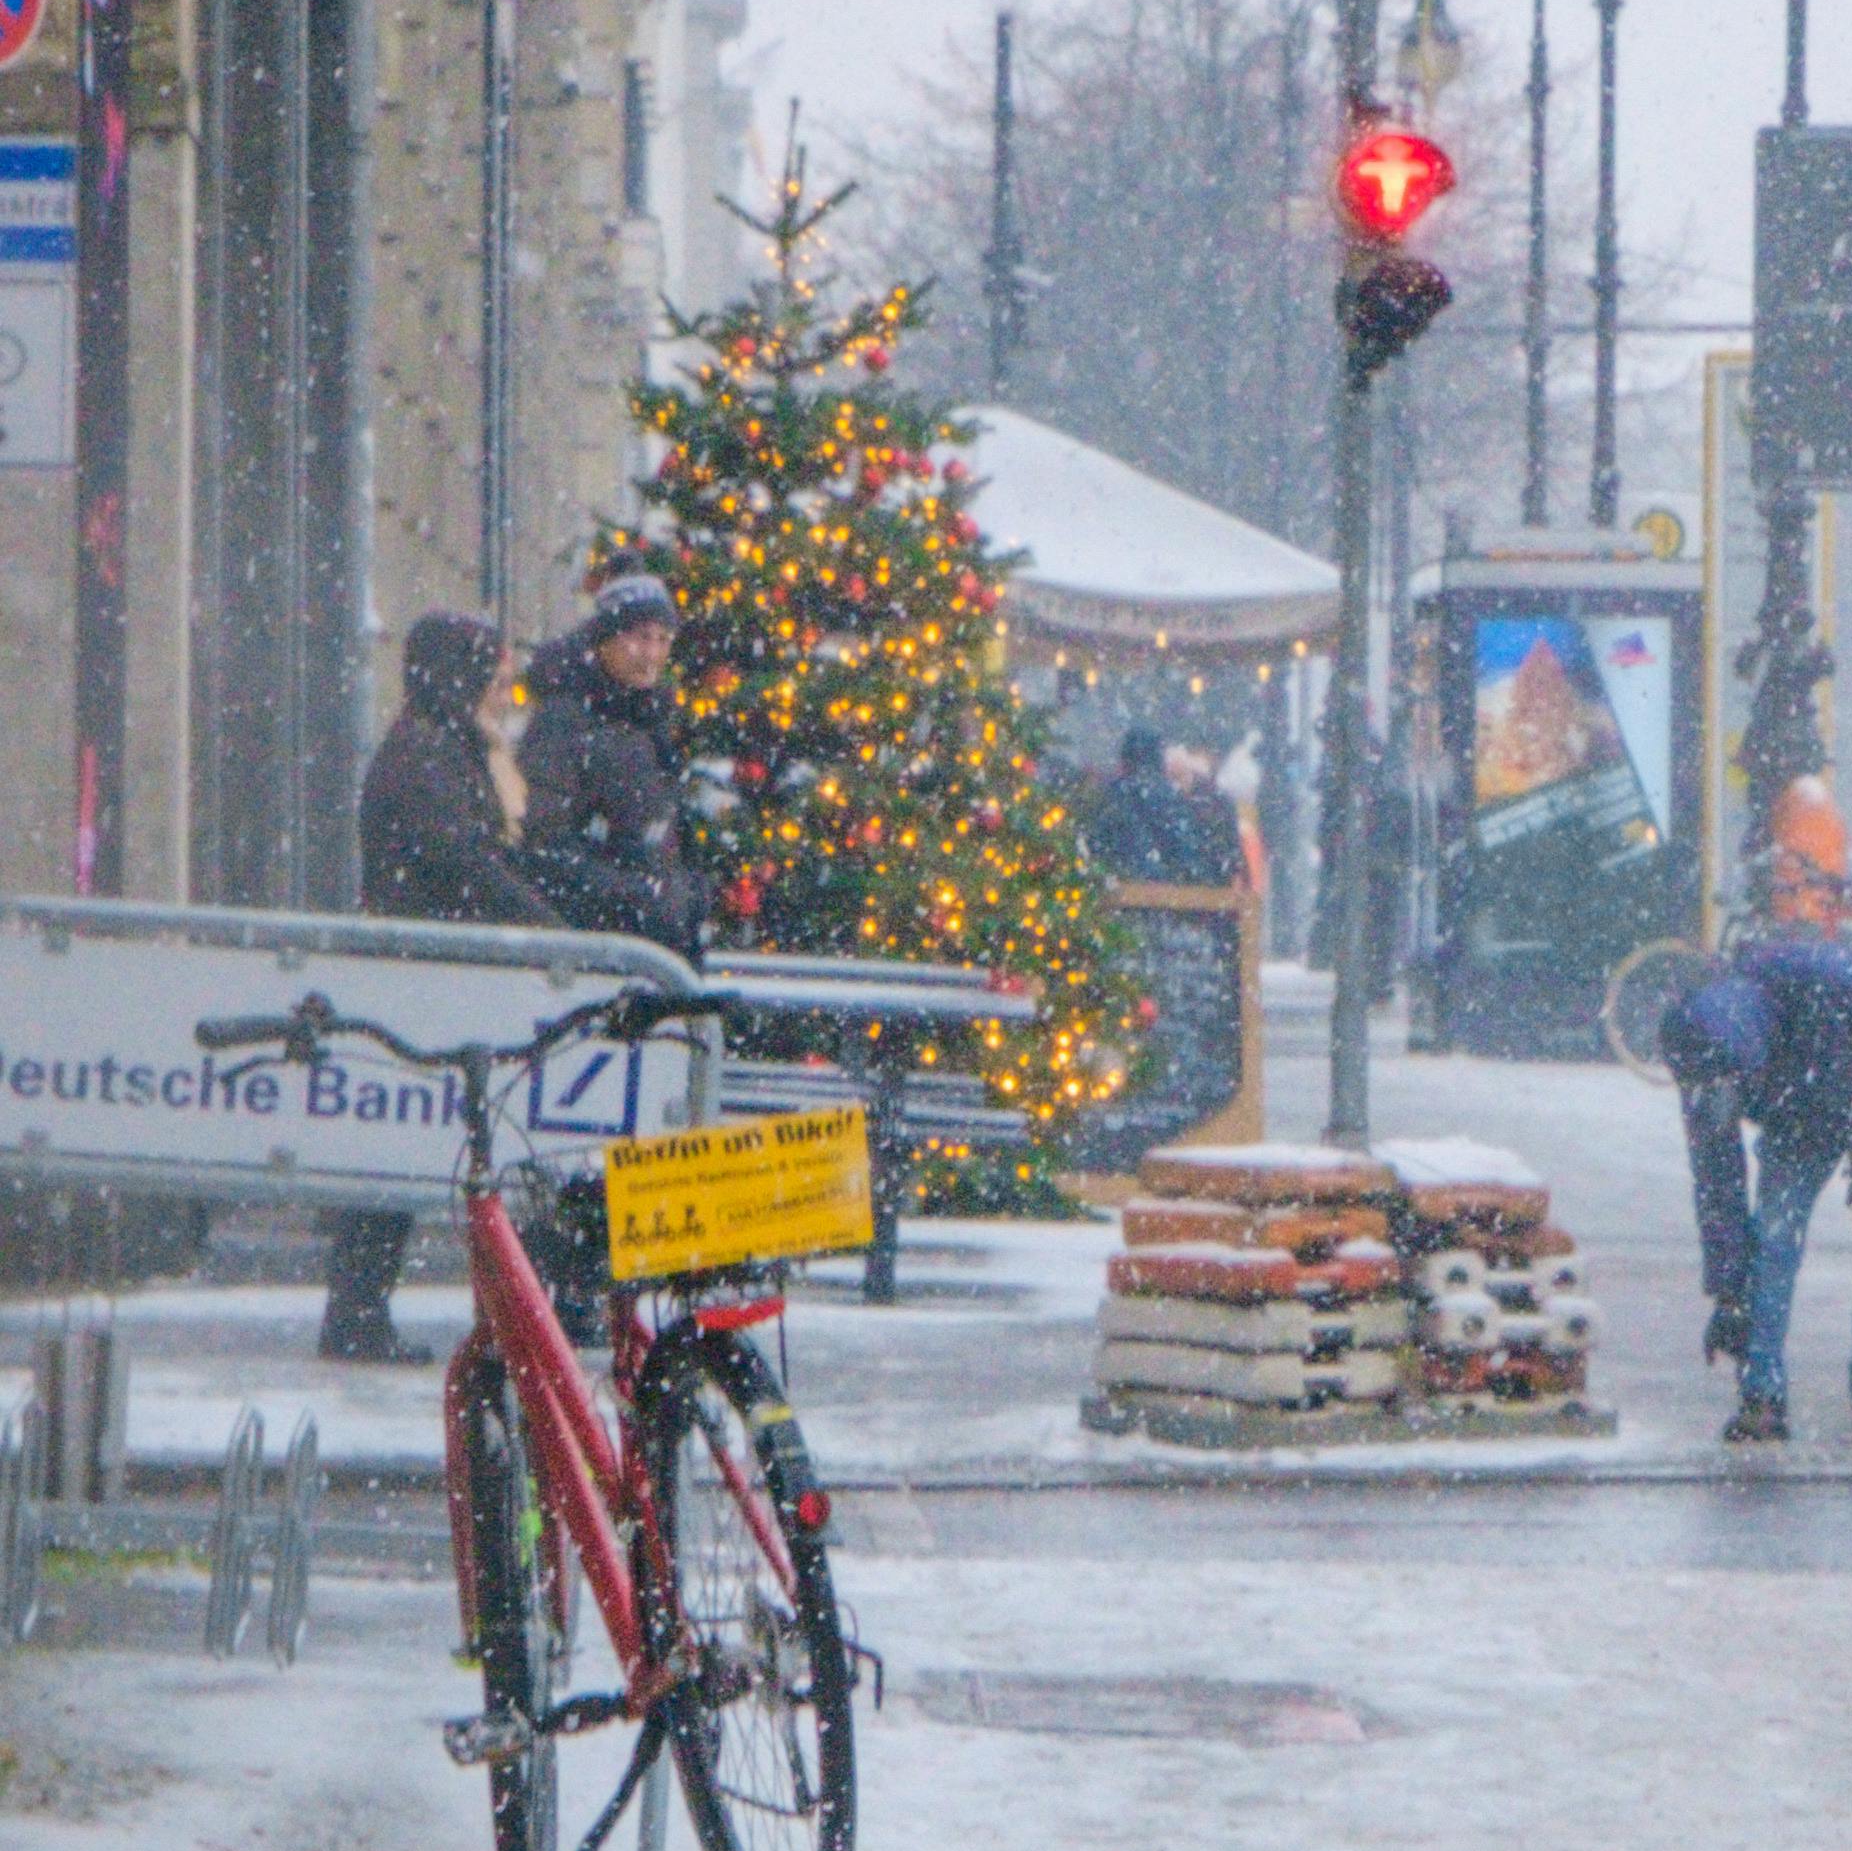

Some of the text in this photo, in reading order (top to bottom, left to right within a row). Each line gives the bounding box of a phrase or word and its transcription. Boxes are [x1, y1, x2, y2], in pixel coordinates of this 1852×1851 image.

[0, 1052, 281, 1114] eutsche
[612, 1133, 712, 1169] Berlin
[724, 1129, 763, 1154] on
